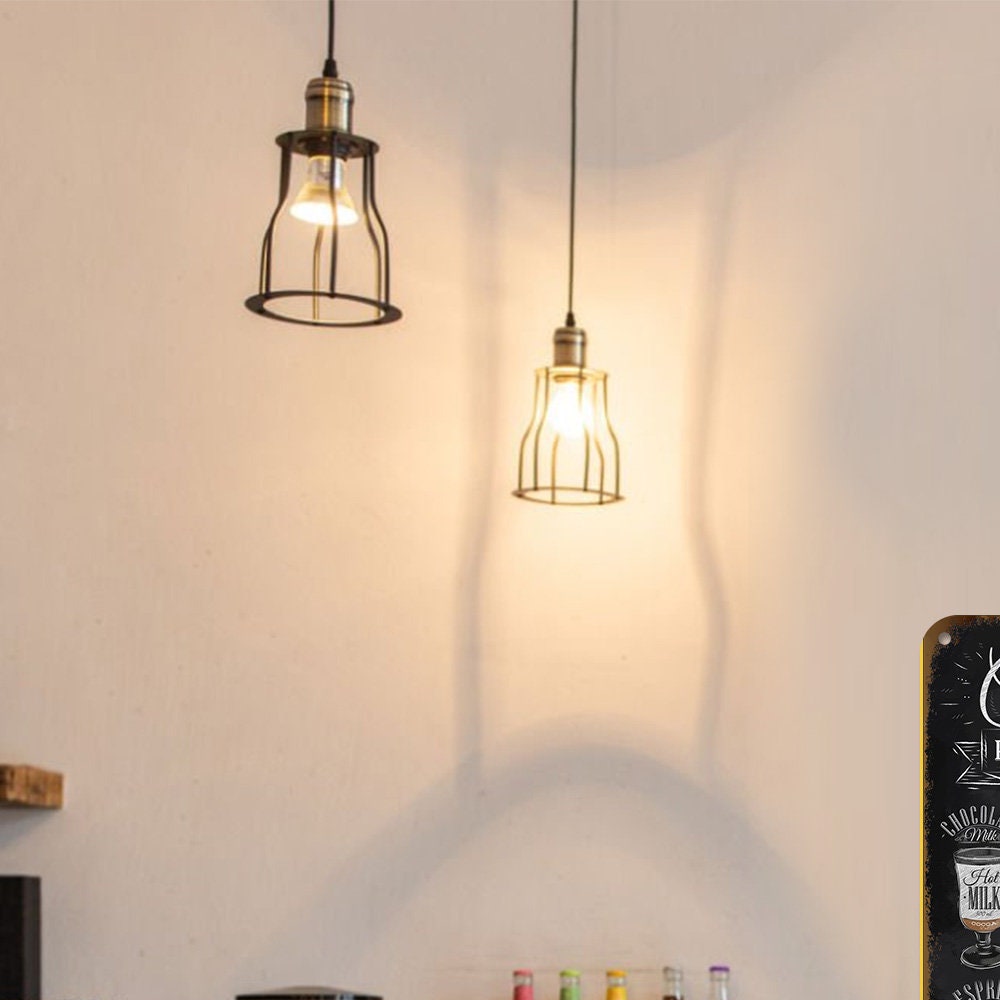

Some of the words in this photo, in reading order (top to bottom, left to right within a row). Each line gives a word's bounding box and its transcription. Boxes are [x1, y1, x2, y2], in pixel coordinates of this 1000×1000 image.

[964, 827, 999, 843] Milk
[963, 868, 1000, 886] Hot
[968, 886, 1000, 910] MILK
